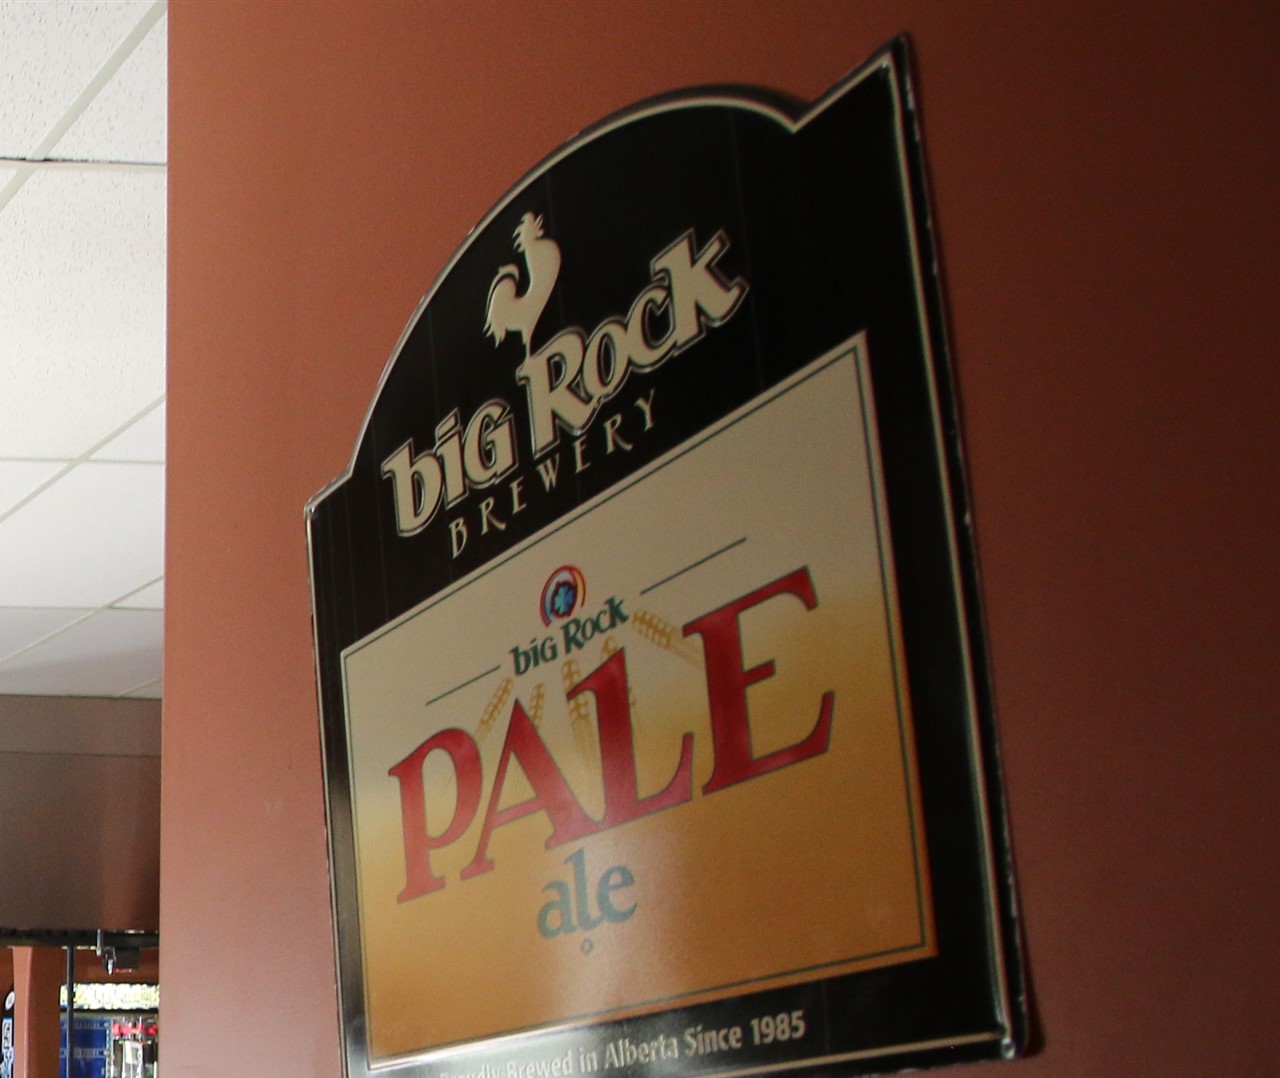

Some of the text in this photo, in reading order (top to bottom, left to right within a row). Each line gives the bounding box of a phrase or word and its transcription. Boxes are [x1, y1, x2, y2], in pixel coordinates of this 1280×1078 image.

[448, 389, 656, 559] BREWERY
[387, 565, 836, 904] PALE
[537, 847, 638, 940] ale
[578, 1047, 598, 1073] in
[604, 1034, 679, 1071] Alberta
[683, 1024, 743, 1057] Since
[750, 1009, 806, 1046] 1985
